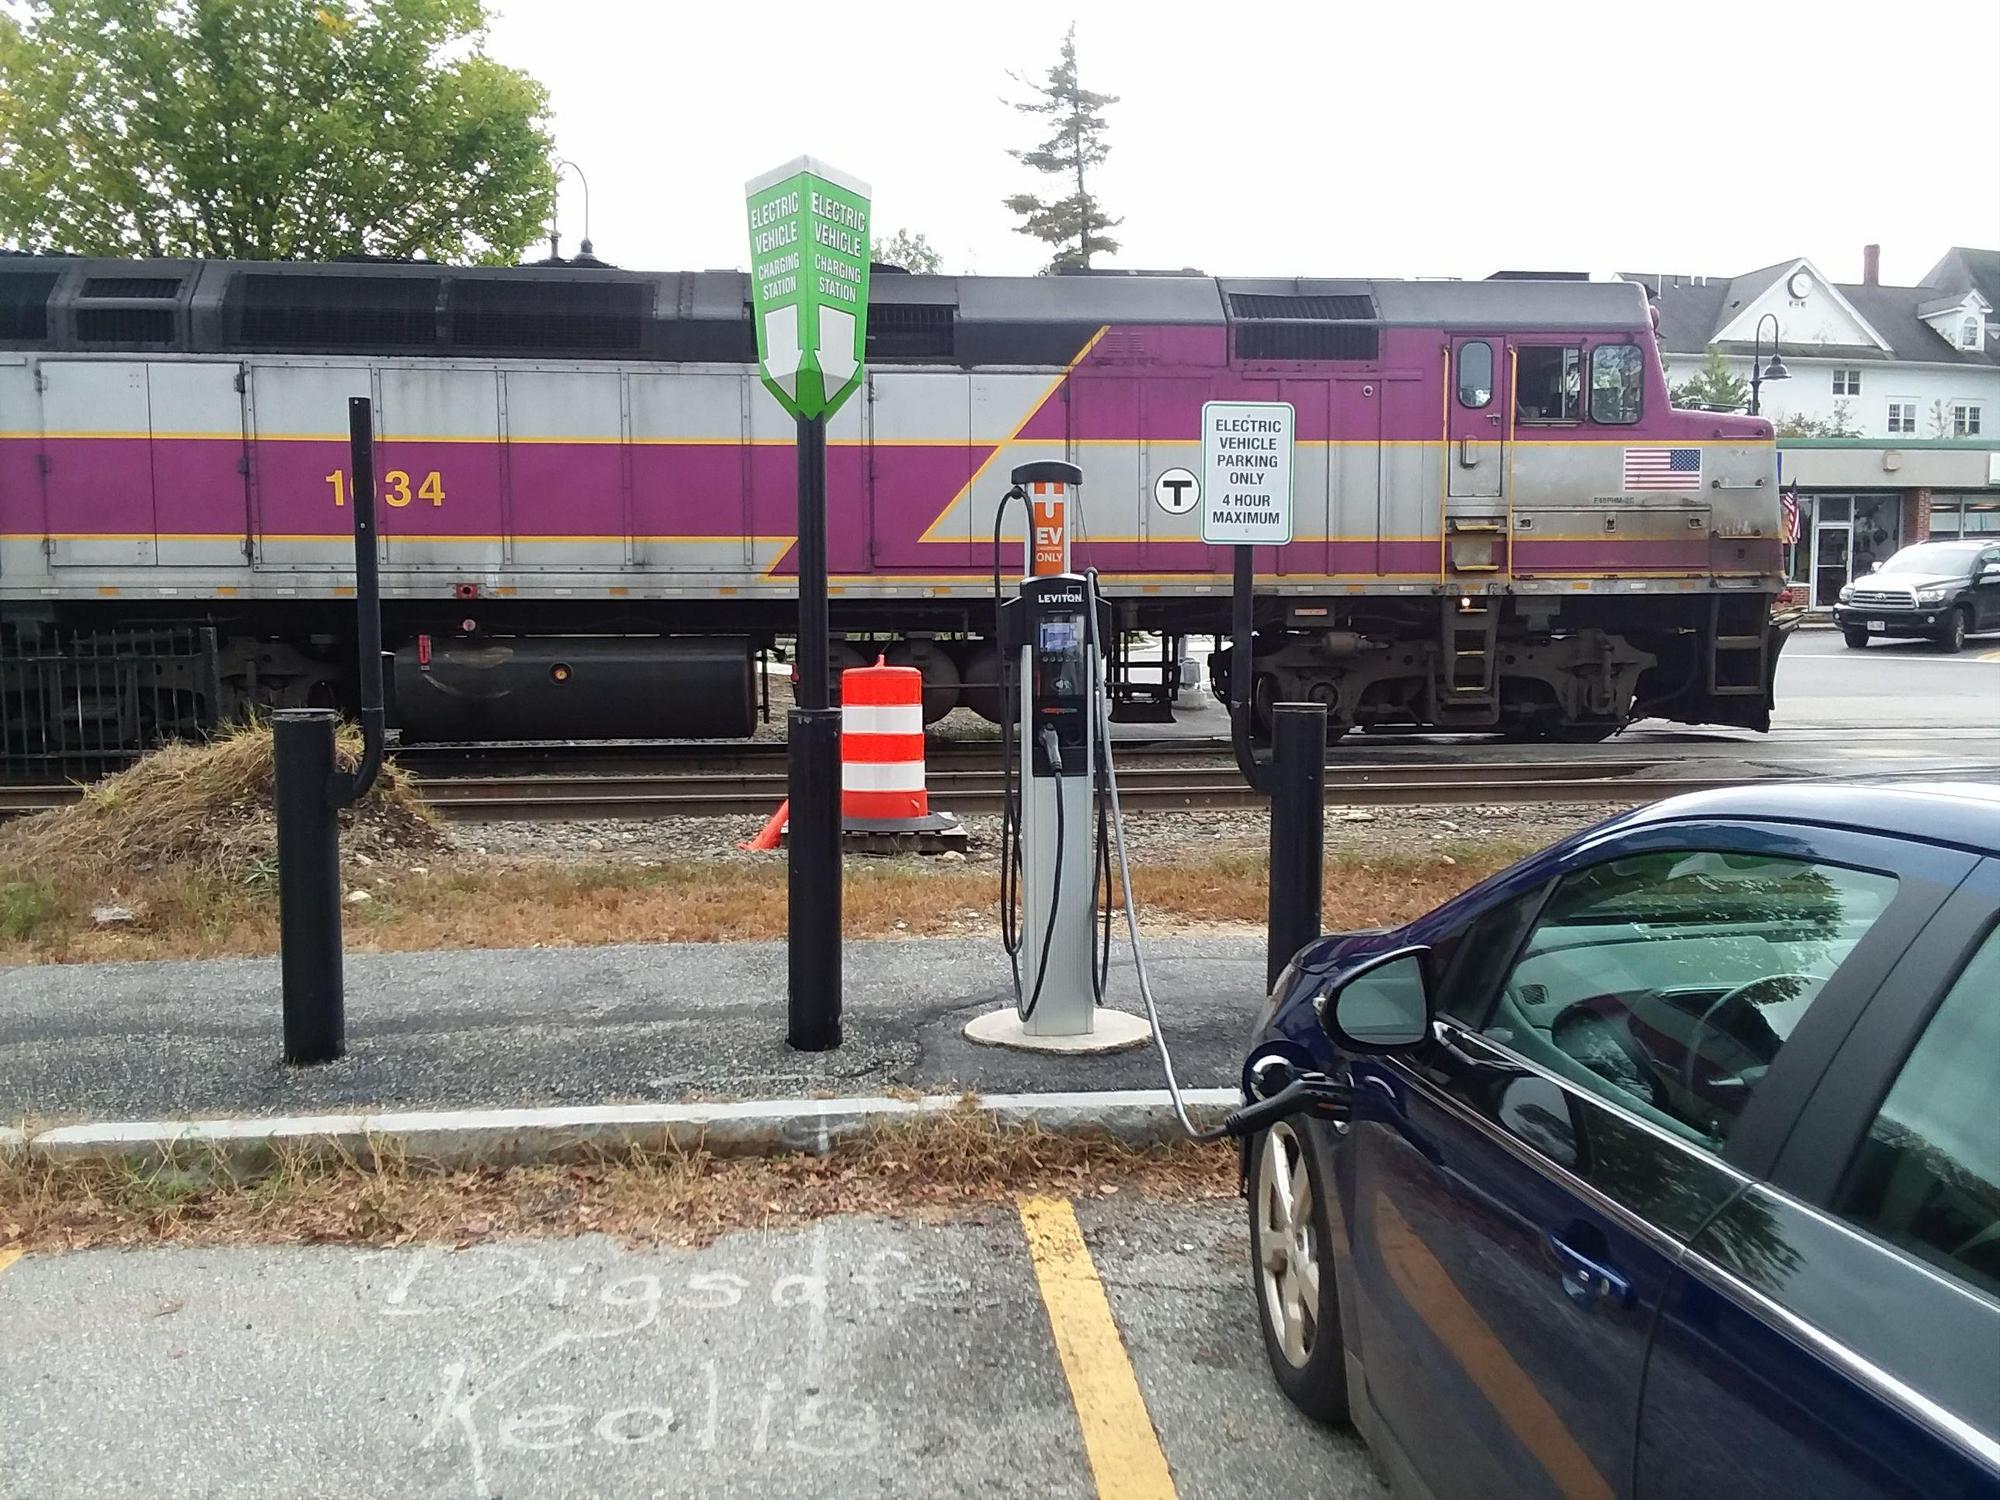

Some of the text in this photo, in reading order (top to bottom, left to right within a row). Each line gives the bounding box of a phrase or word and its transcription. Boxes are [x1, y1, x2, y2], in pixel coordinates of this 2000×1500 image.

[752, 191, 799, 230] ELECTRIC
[811, 191, 865, 232] ELECTRIC
[755, 220, 798, 254] VEHICLE
[814, 220, 862, 258] VEHICLE
[758, 252, 800, 281] CHARGING
[815, 253, 861, 284] CHARGING
[763, 275, 797, 301] STATION
[819, 276, 857, 303] STATION
[1215, 419, 1282, 433] ELECTRIC
[1219, 437, 1277, 450] VEHICLE
[1217, 454, 1278, 468] PARKING
[325, 470, 446, 507] 134
[1229, 472, 1265, 485] ONLY
[1162, 480, 1192, 506] T
[1222, 494, 1271, 507] 4 HOUR
[1212, 511, 1280, 525] MAXIMUM
[1036, 527, 1063, 545] EV
[1036, 552, 1063, 562] ONLY
[1038, 593, 1082, 604] LEVITON
